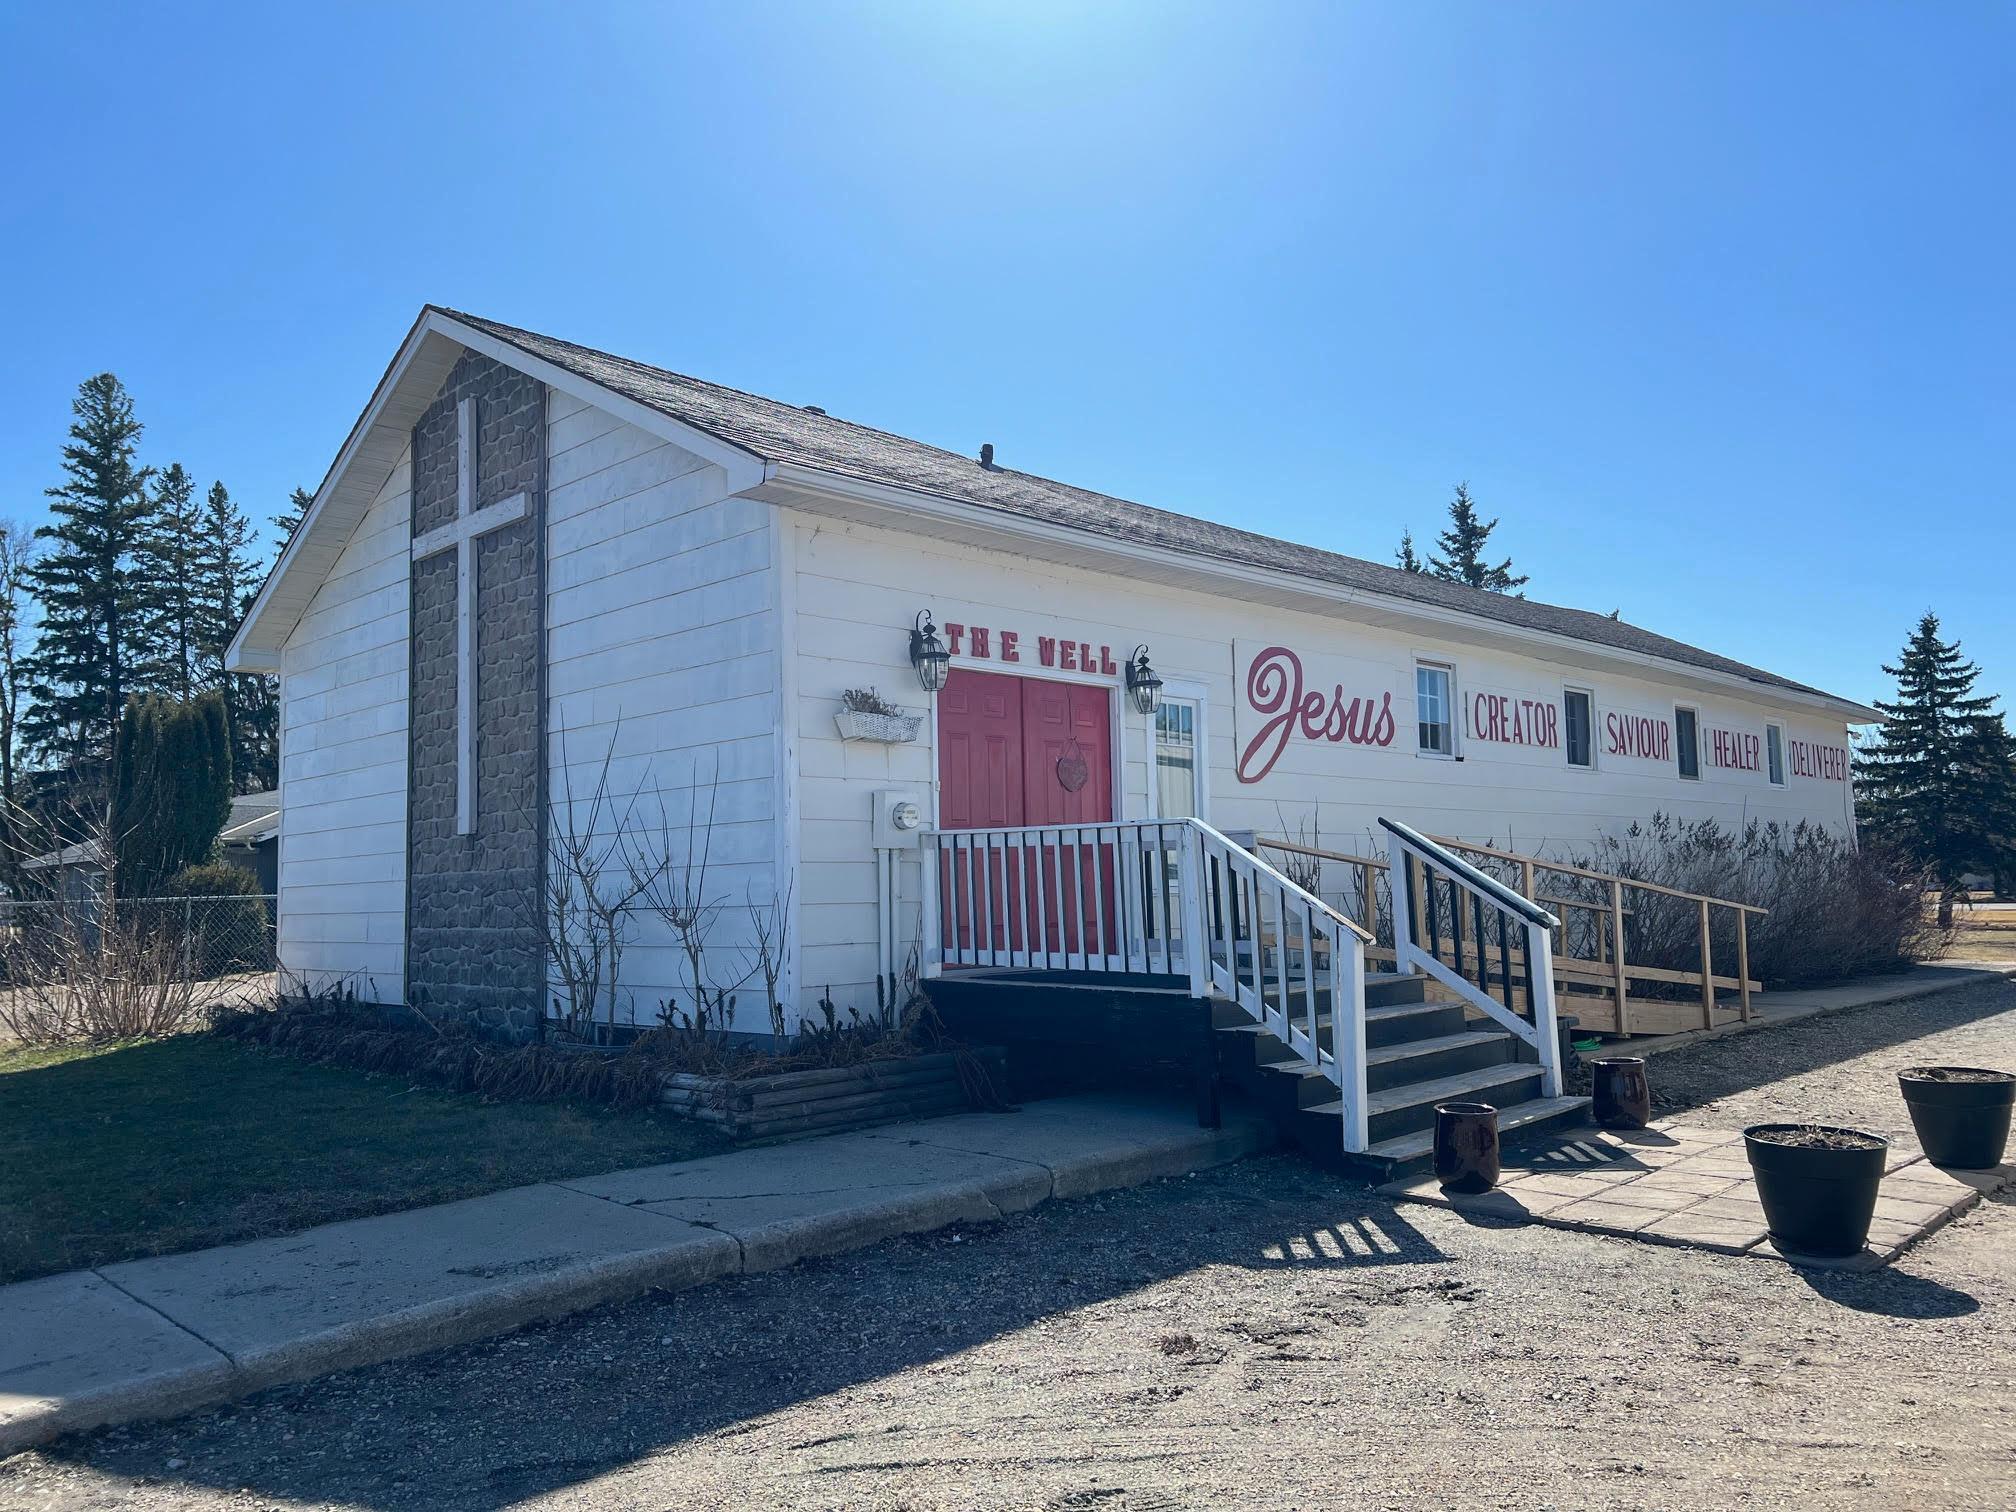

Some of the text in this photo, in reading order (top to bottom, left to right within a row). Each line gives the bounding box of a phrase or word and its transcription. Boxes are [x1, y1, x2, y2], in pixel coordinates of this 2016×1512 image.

[945, 623, 1117, 675] THE WELL
[1237, 646, 1396, 784] Jesus
[1474, 693, 1558, 748] CREATOR
[1607, 712, 1670, 761] SAVIOUR
[1713, 729, 1760, 772] HEALER
[1792, 741, 1847, 781] DELIVERER
